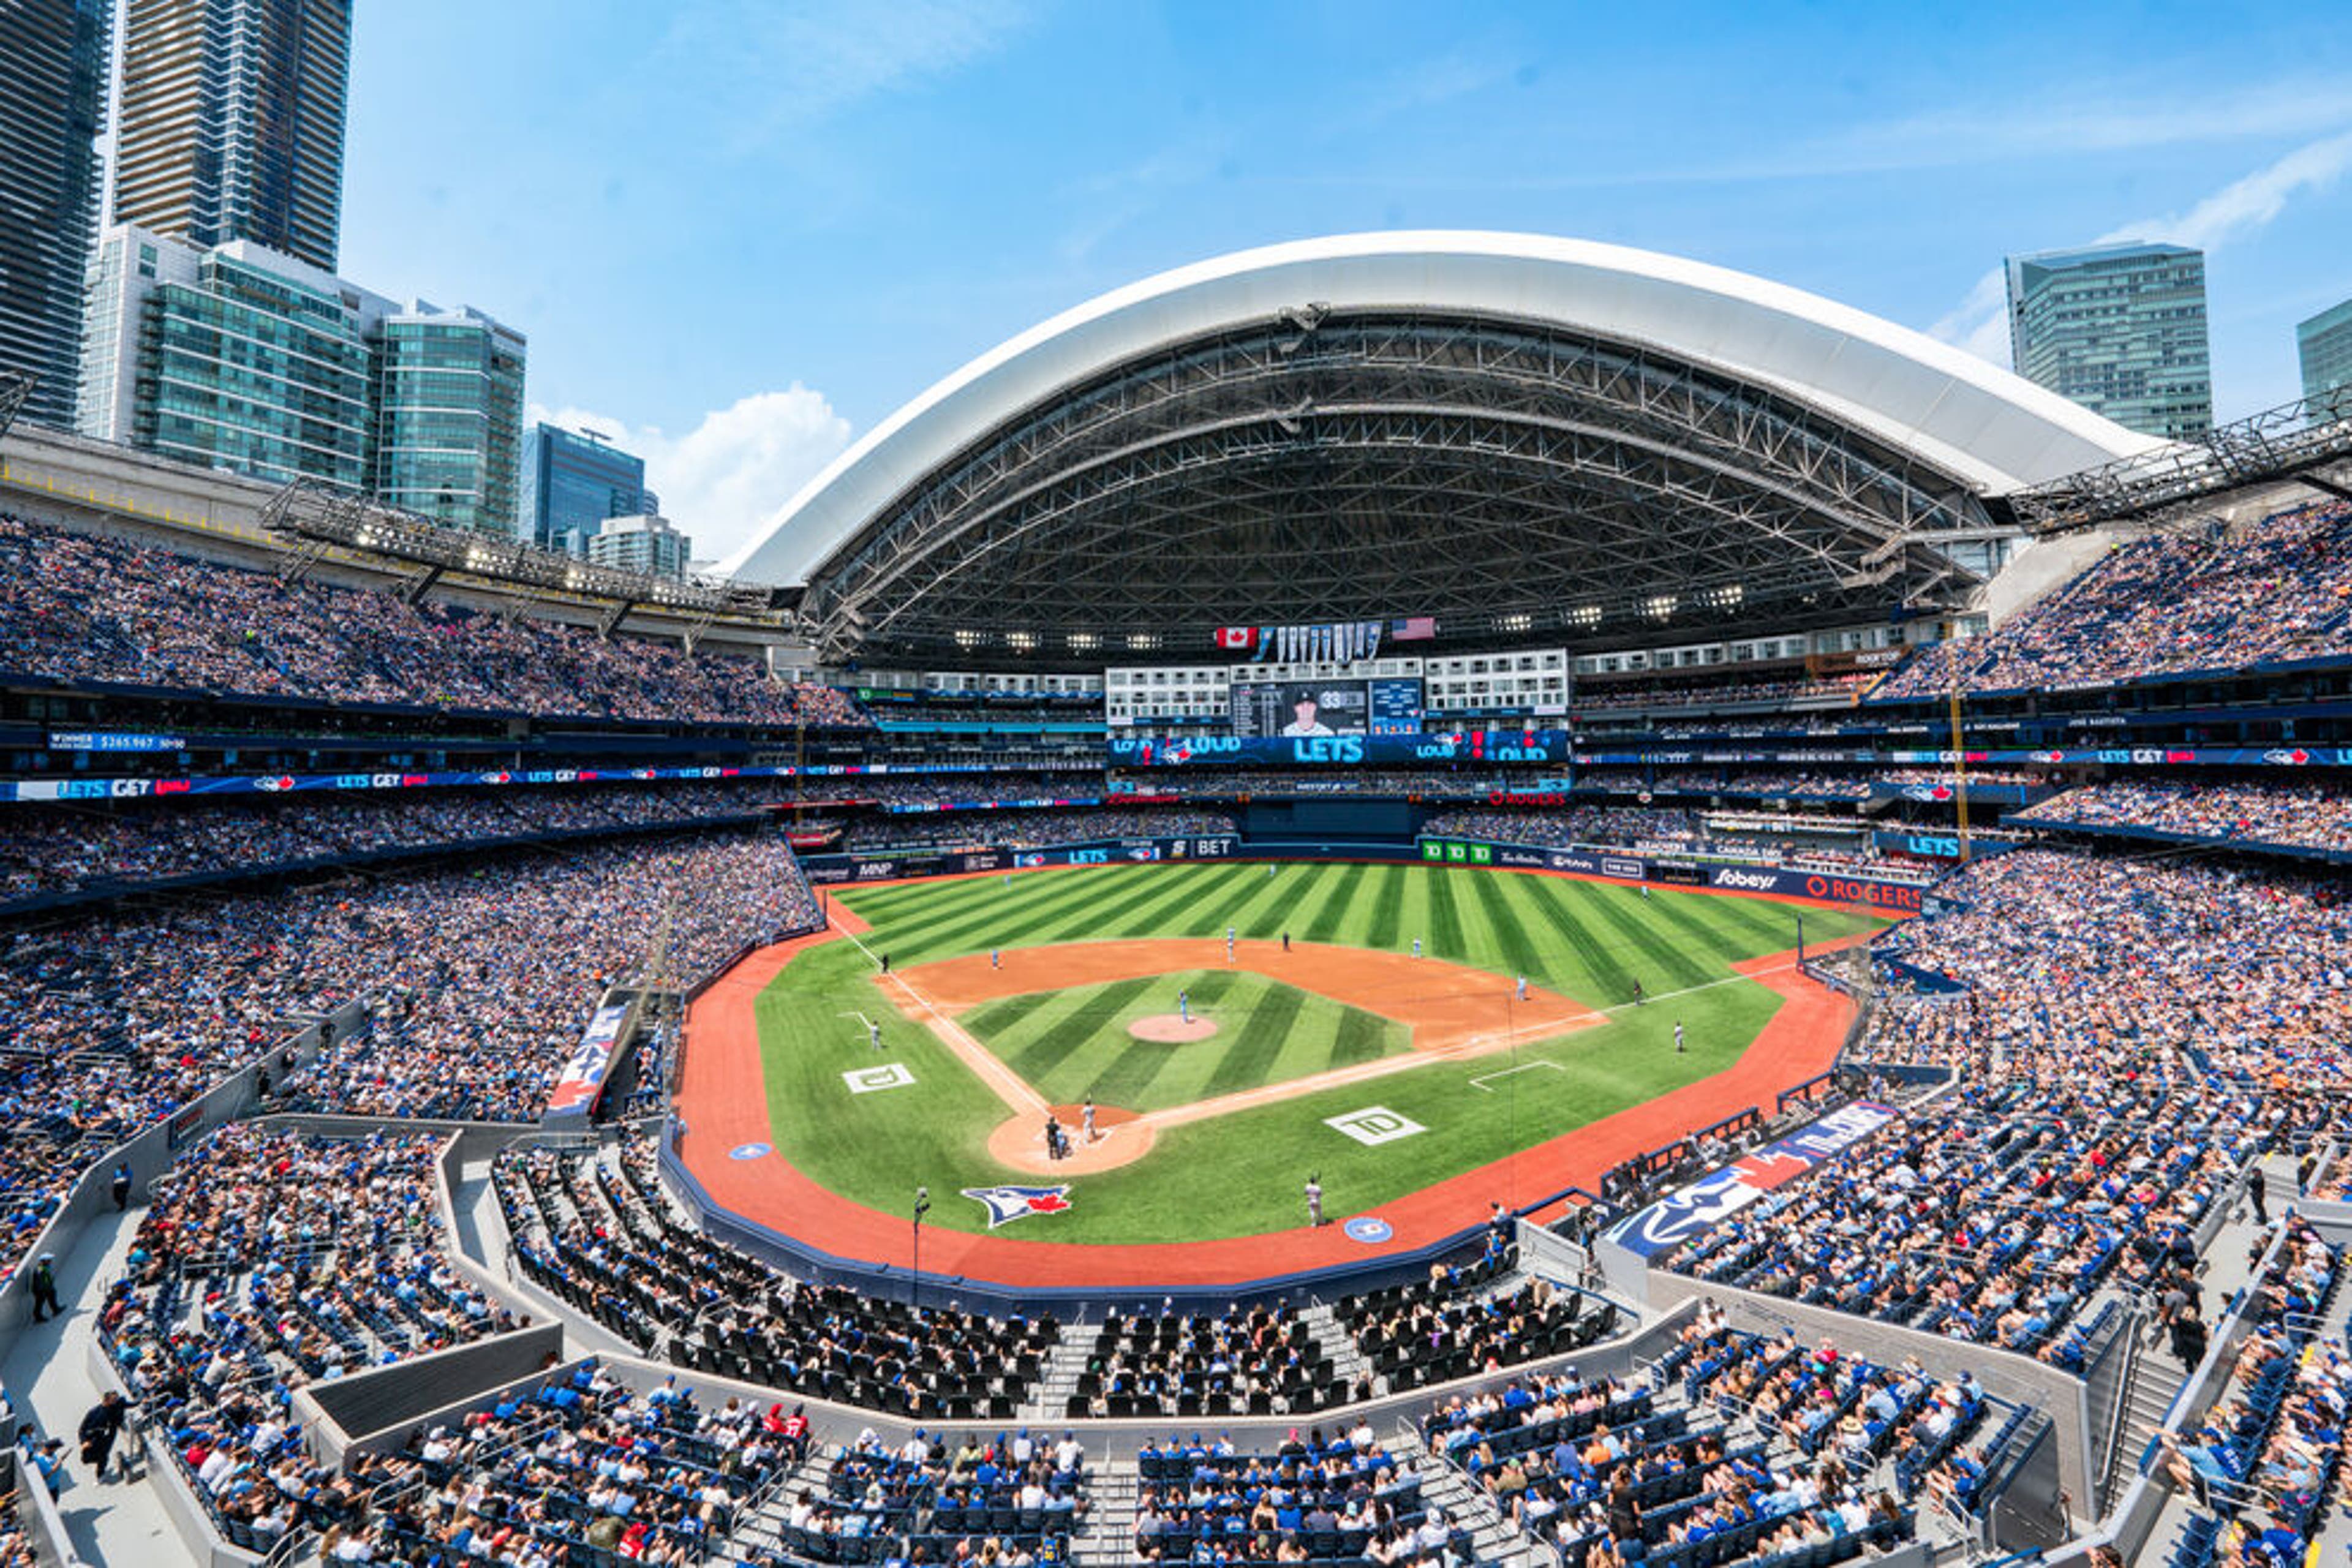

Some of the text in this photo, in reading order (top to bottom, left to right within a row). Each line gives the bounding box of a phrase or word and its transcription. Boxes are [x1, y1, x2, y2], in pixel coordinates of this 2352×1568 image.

[1320, 690, 1342, 709] 33
[1294, 736, 1363, 763] LETS
[2098, 750, 2130, 763] LETS
[2132, 750, 2163, 763] GET
[337, 775, 369, 789] LETS
[372, 774, 400, 788] GET
[529, 771, 552, 782] LETS
[555, 769, 576, 782] GET
[58, 780, 106, 799] LETS
[111, 779, 151, 796] GET
[1506, 793, 1566, 805] ROGERS
[1197, 839, 1231, 855] BET
[1909, 836, 1959, 857] LETS
[1069, 850, 1107, 864] LETS
[859, 862, 892, 876] MNP
[1833, 880, 1921, 908] ROGERS
[1342, 1113, 1404, 1136] TD
